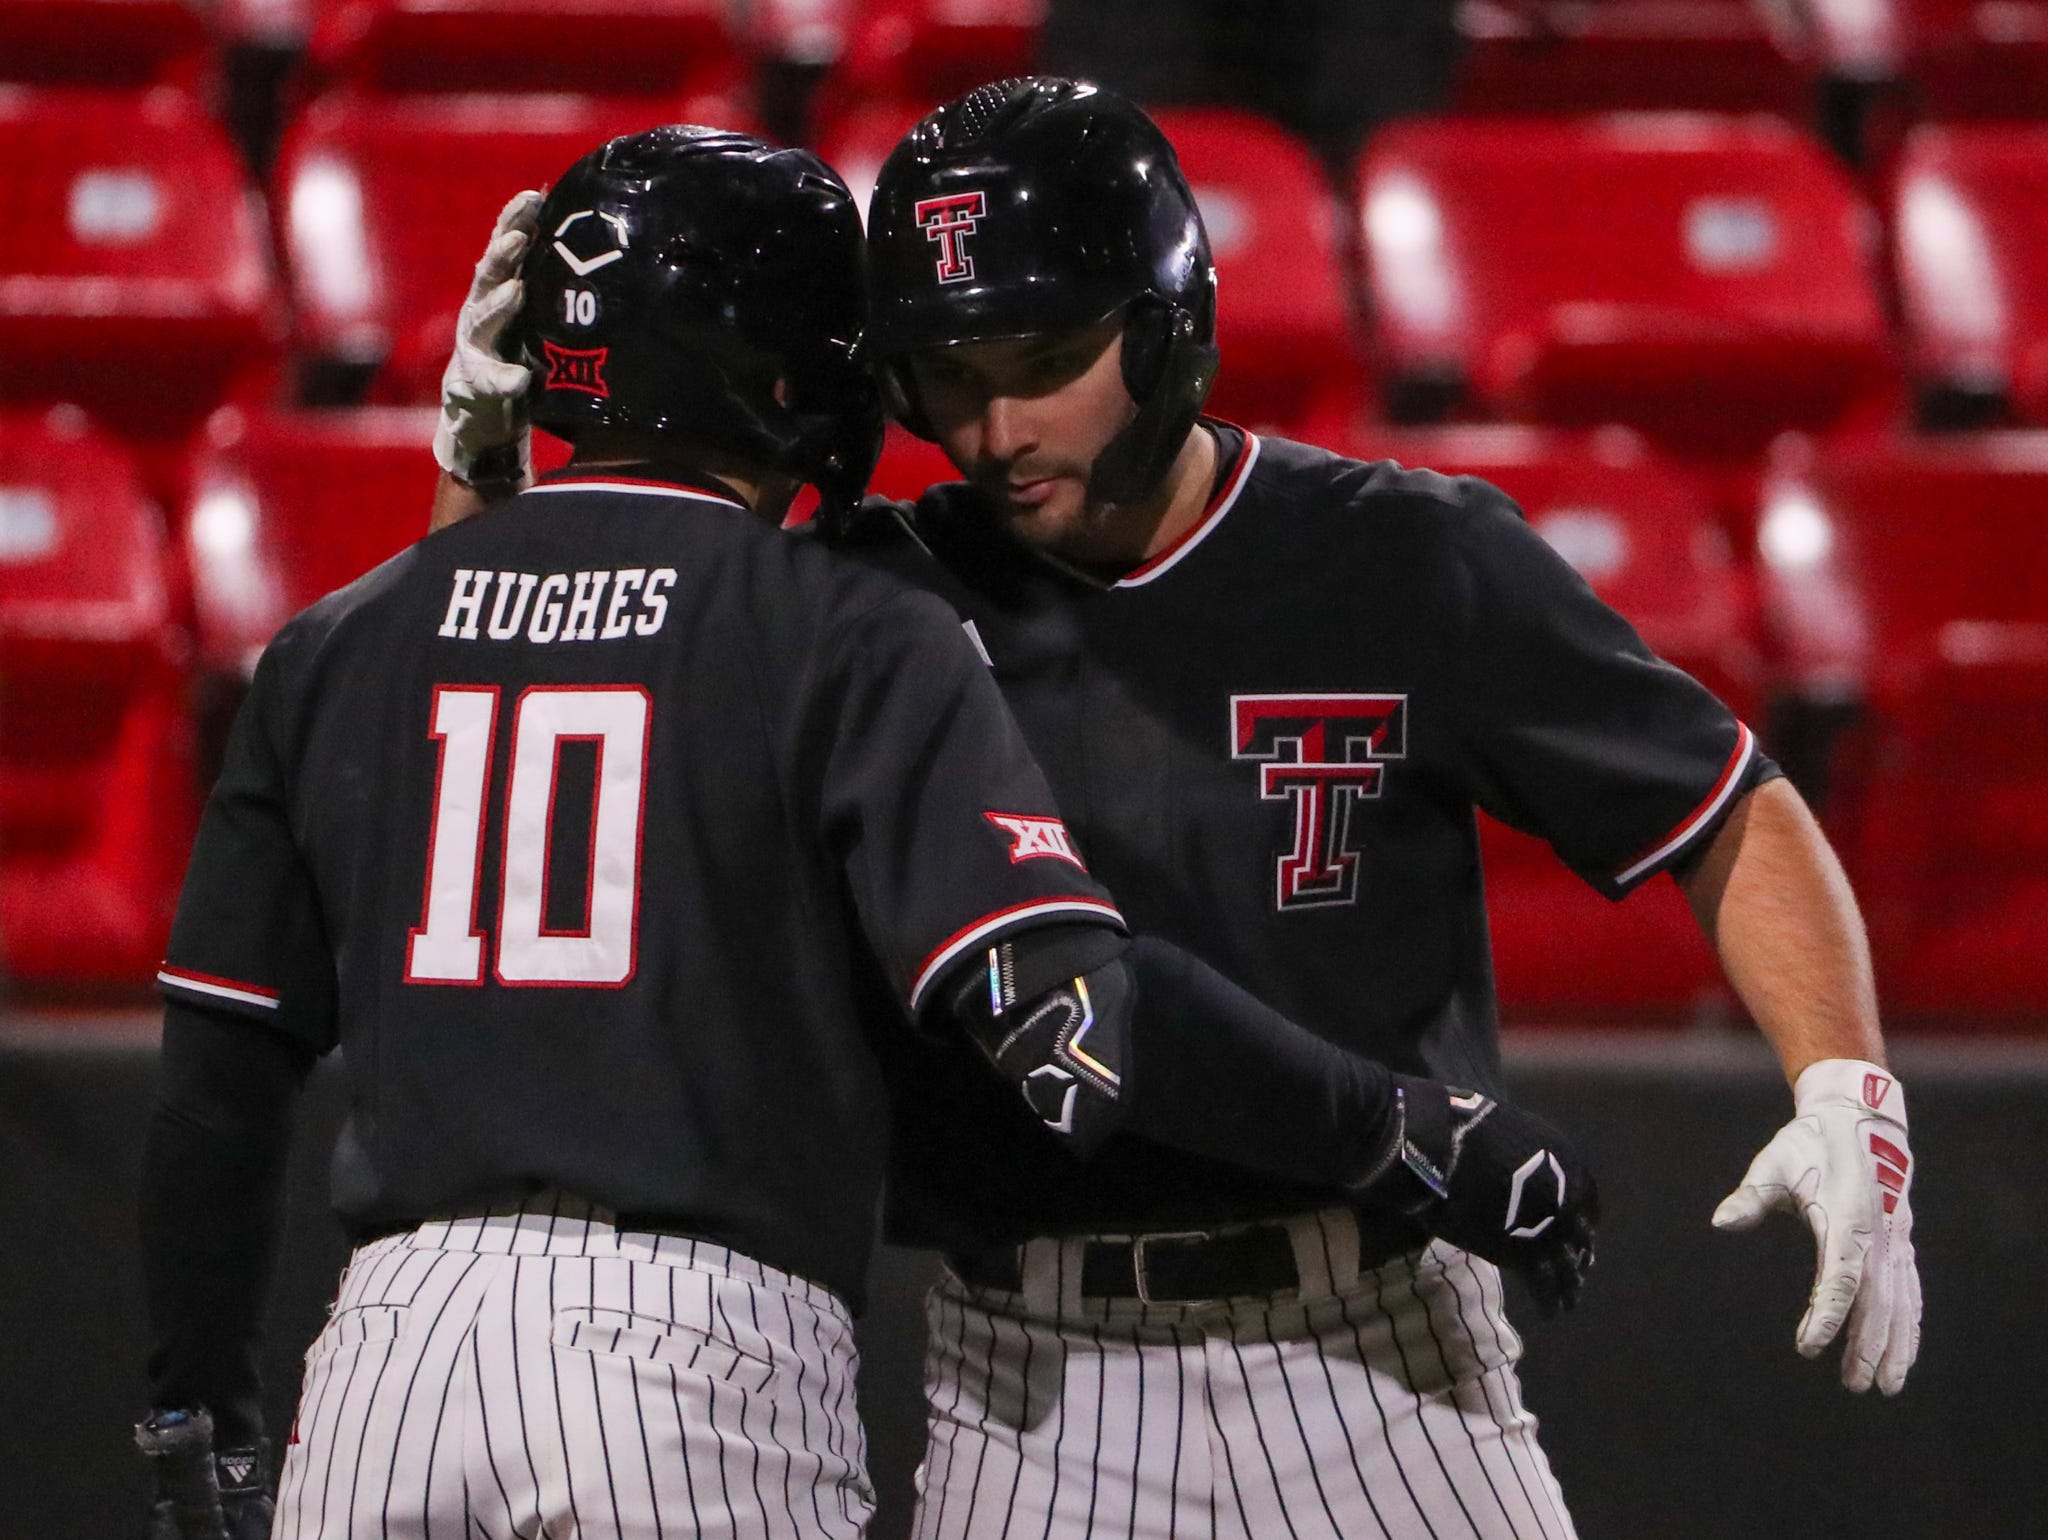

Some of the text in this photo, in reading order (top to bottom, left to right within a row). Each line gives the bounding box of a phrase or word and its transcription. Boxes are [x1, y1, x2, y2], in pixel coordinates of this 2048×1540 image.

[565, 289, 596, 326] 10
[438, 568, 678, 643] HUGHES
[403, 683, 654, 988] 10
